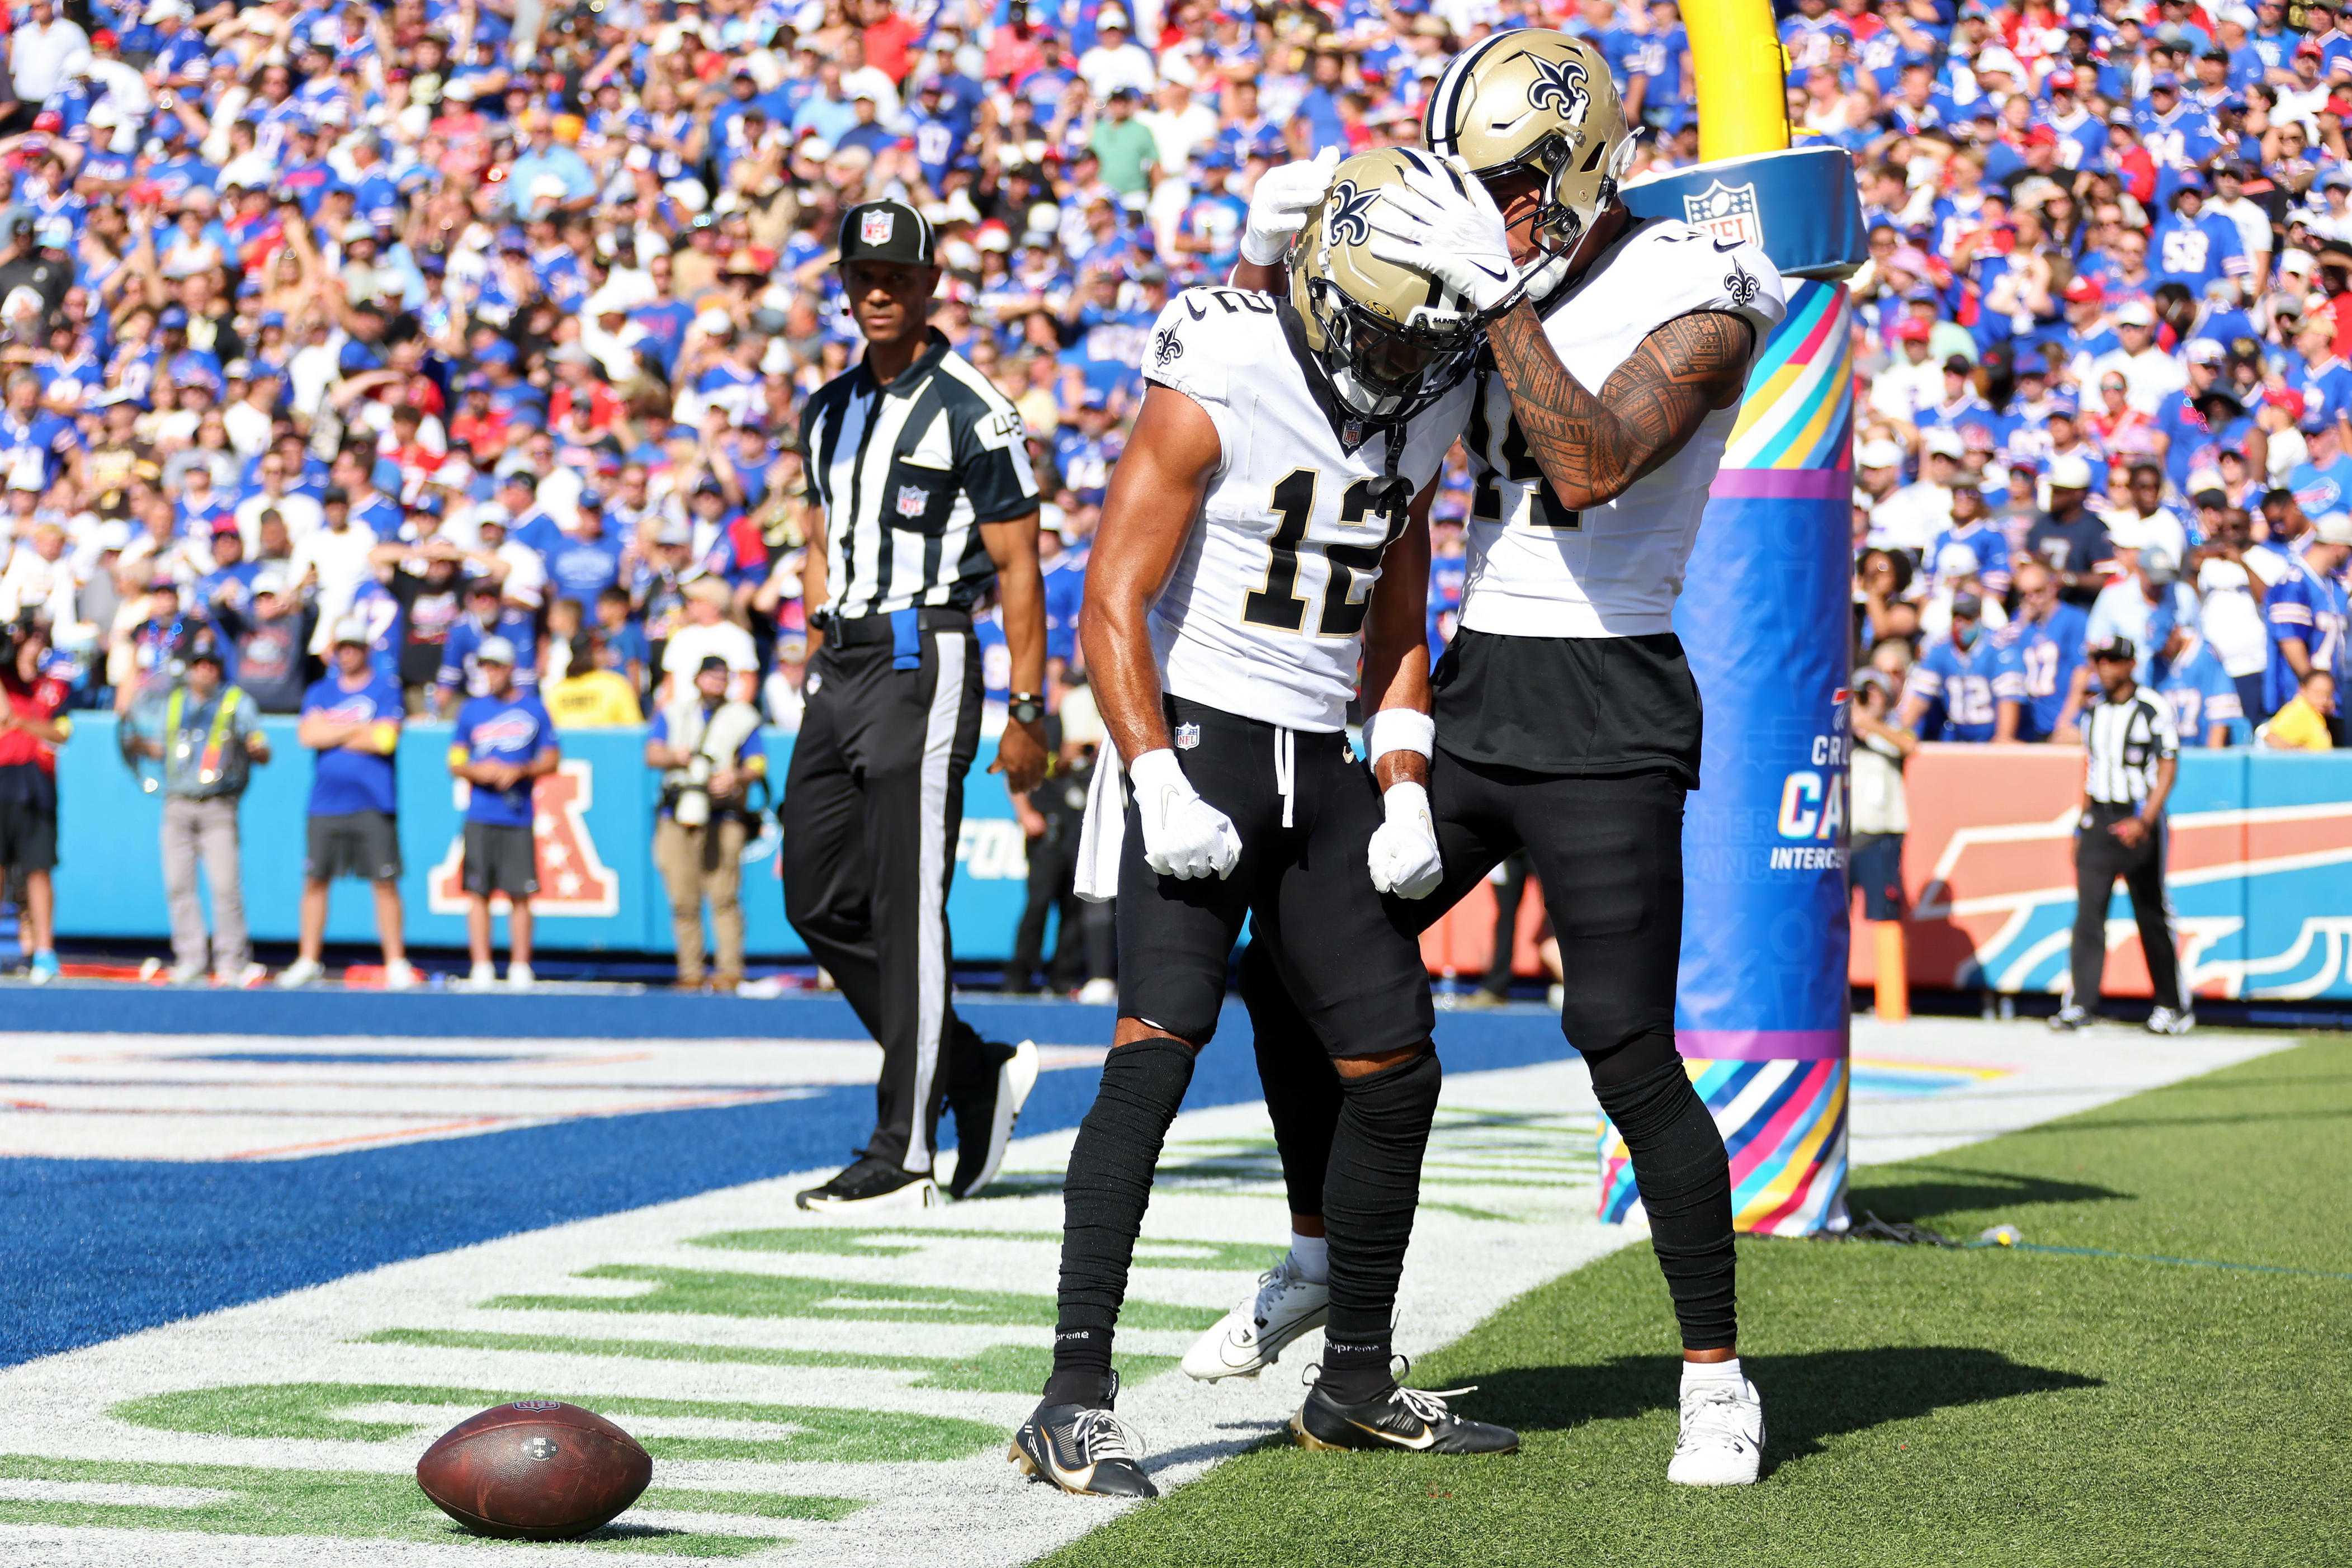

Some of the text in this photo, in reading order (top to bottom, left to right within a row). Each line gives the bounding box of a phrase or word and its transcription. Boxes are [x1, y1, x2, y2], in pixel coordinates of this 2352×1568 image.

[865, 224, 889, 239] NFL
[1432, 317, 1458, 325] SAINTS
[1346, 430, 1358, 442] NFL
[901, 498, 921, 513] NFL
[1240, 466, 1411, 639] 12
[1944, 674, 1995, 726] 12
[1178, 735, 1196, 745] NFL
